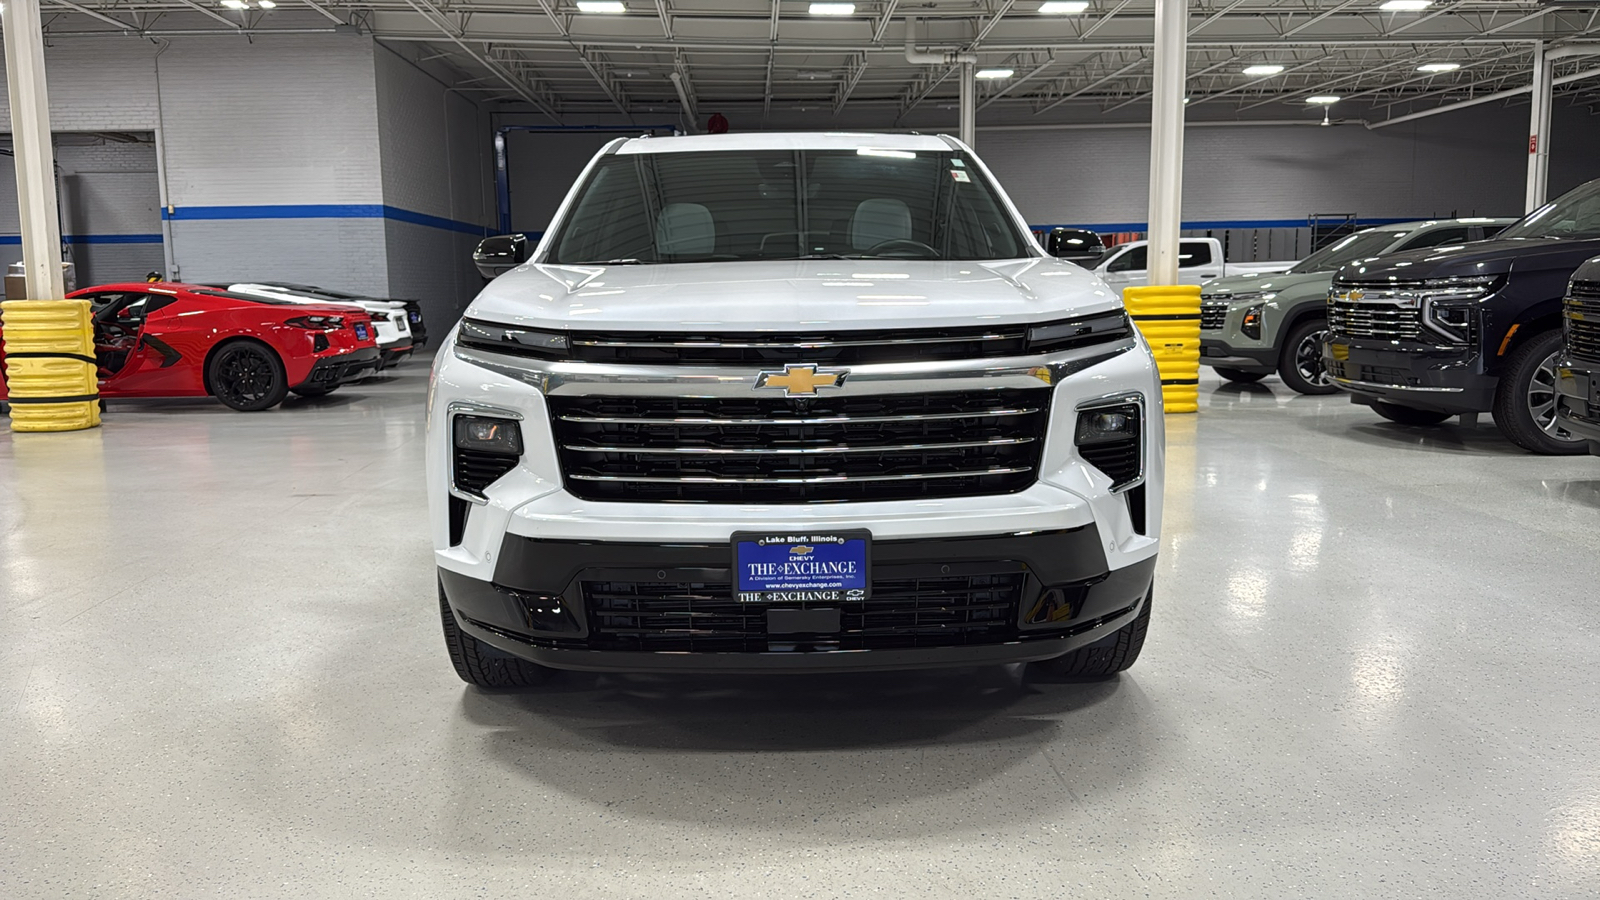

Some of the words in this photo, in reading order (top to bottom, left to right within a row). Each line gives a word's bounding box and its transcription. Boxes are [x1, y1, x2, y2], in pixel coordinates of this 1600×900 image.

[747, 563, 777, 576] THE
[784, 561, 857, 575] EXCHANGE
[738, 592, 762, 602] THE
[772, 591, 839, 602] EXCHANGE
